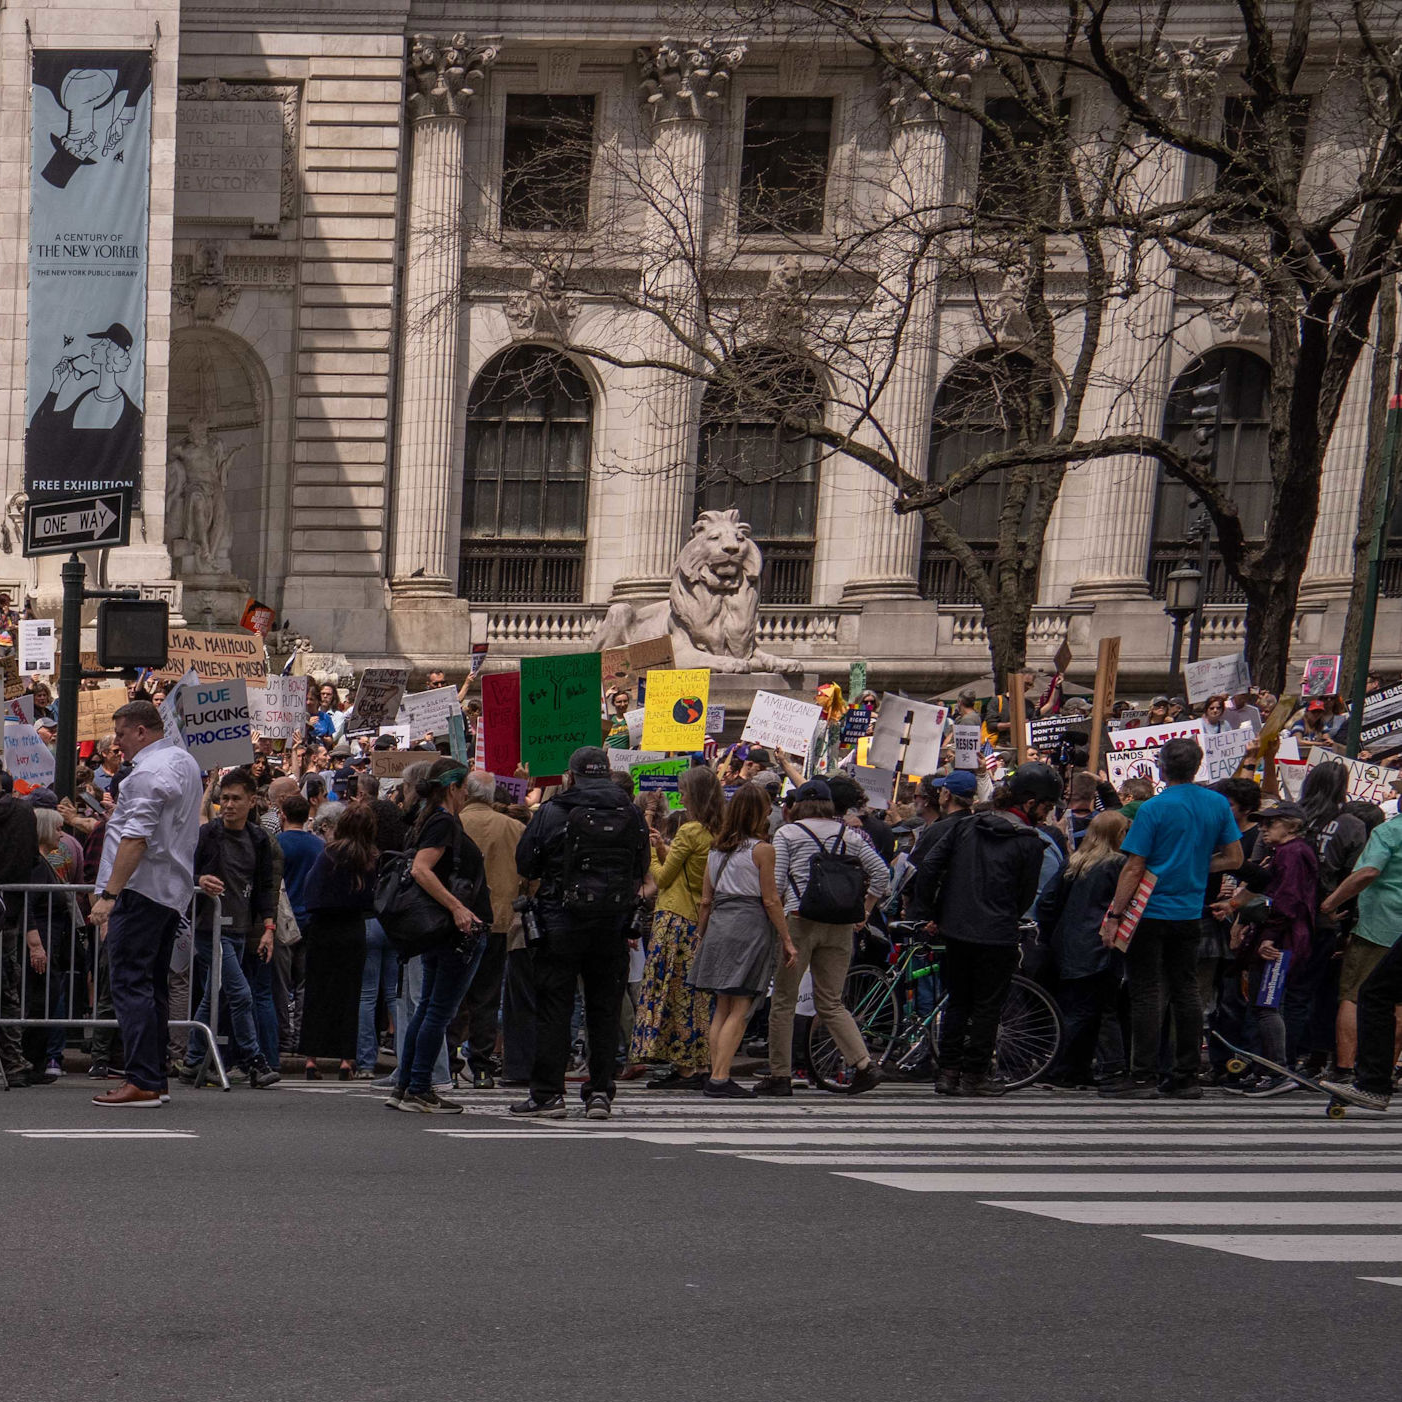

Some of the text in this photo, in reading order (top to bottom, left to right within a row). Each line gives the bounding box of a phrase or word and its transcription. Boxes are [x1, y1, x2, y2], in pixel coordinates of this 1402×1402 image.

[186, 131, 237, 145] TRUTH
[227, 154, 269, 168] AWAY
[196, 175, 261, 190] VICTORY
[64, 234, 109, 242] CENTURY
[110, 234, 123, 242] OF
[37, 245, 140, 258] THE NEW YORKER
[32, 480, 60, 490] FREE
[43, 510, 107, 534] ONE WAY
[204, 637, 257, 655] MAHMOUD
[197, 688, 231, 705] DUE
[265, 693, 304, 707] TO PUTIN
[764, 694, 816, 717] AMERICANS
[185, 706, 250, 727] FUCKING
[265, 710, 292, 722] STAND
[772, 710, 797, 723] MUST
[1032, 716, 1082, 728] DEMOCRACIES
[773, 720, 805, 736] TOGETHER
[1032, 727, 1053, 735] DON'T
[1360, 722, 1390, 742] CECOT
[187, 724, 250, 747] PROCESS
[528, 731, 587, 746] DEMOCRACY
[1208, 733, 1239, 748] MELT
[955, 739, 978, 750] RESIST
[1109, 751, 1143, 762] HANDS
[1220, 748, 1235, 757] NOT
[1348, 760, 1391, 782] NOT
